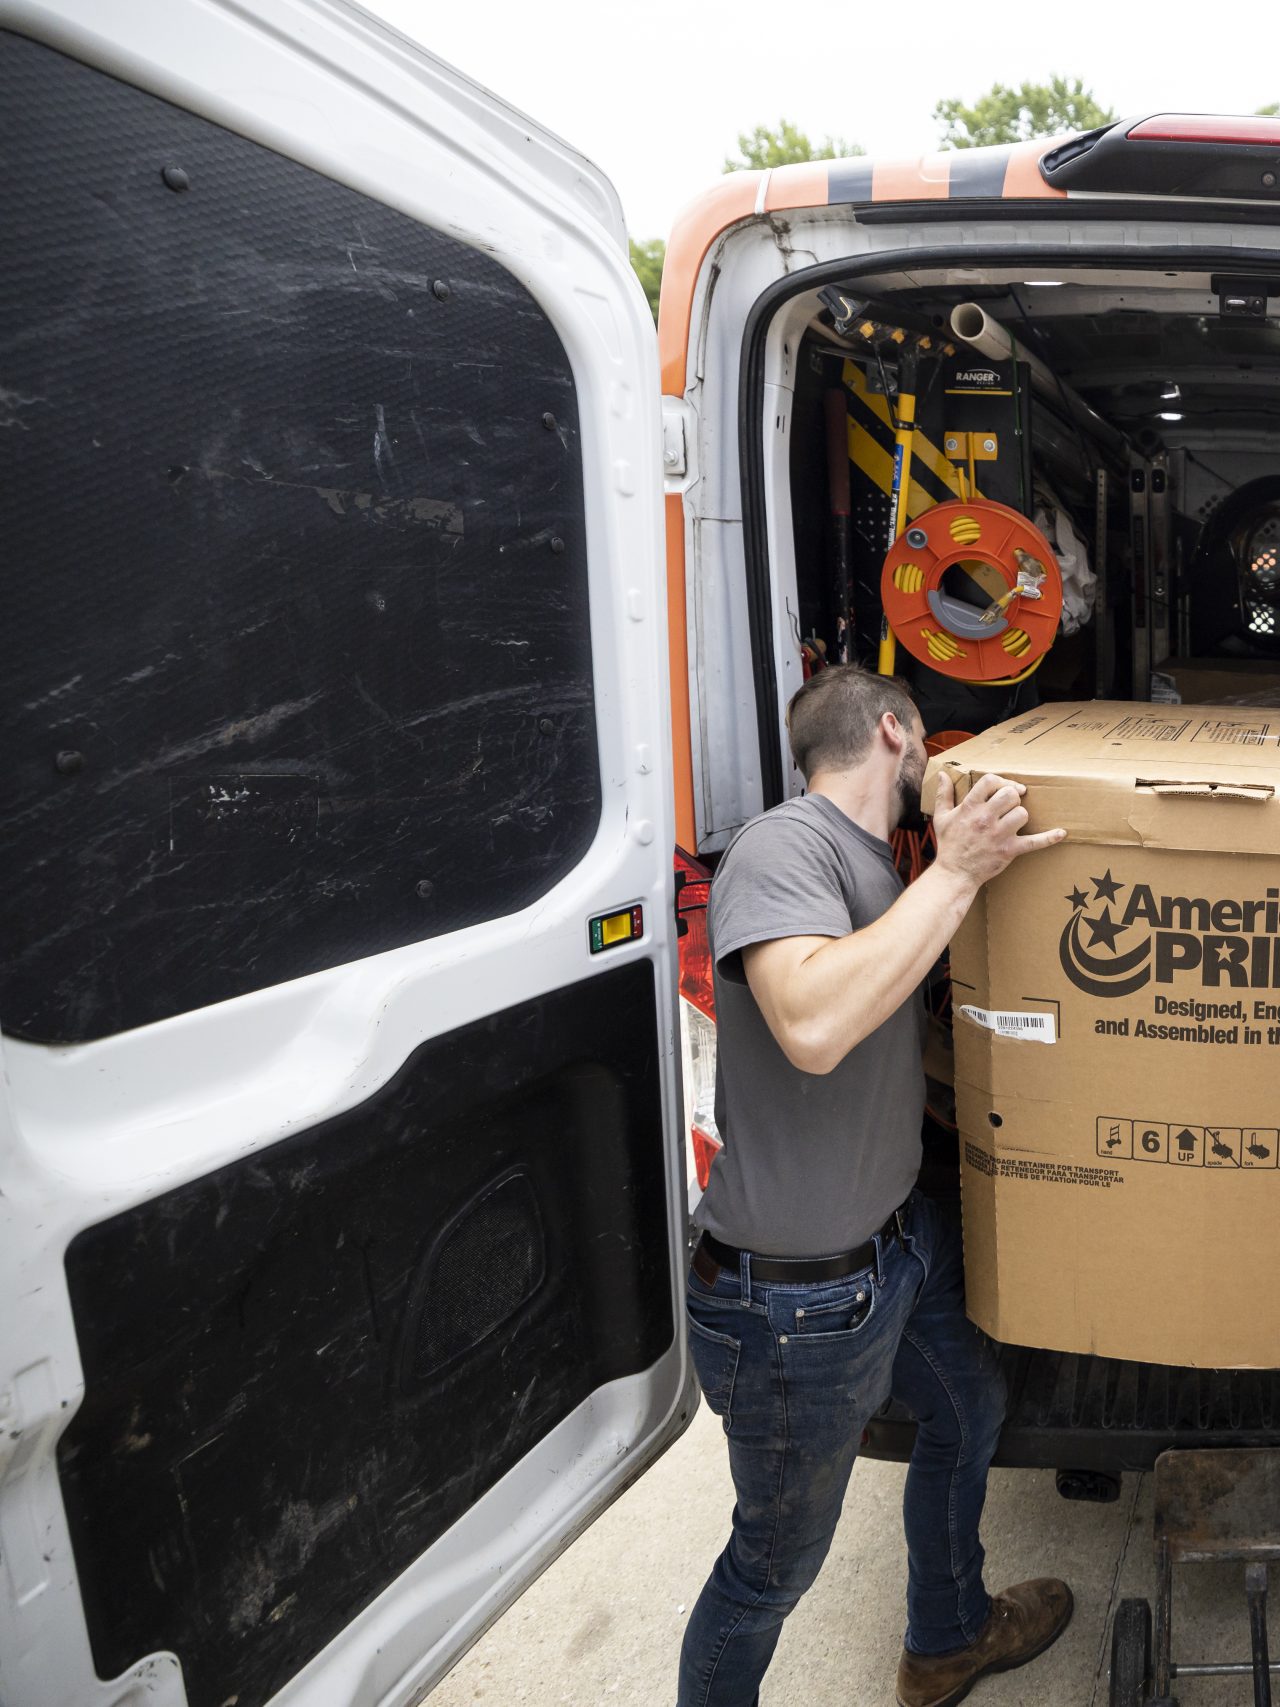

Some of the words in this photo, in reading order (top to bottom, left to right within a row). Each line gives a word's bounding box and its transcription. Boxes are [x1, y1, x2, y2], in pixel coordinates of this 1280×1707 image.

[956, 372, 994, 381] RANGER
[1154, 996, 1247, 1022] Designed,
[1095, 1018, 1128, 1036] and
[1134, 1019, 1238, 1044] Assembled
[1244, 1026, 1261, 1044] in
[1142, 1130, 1160, 1153] 6
[1178, 1152, 1195, 1162] UP
[1001, 1165, 1045, 1174] RETENEDOR
[1047, 1169, 1067, 1177] PARA
[1069, 1172, 1124, 1183] TRANSPORTAR
[1018, 1160, 1055, 1169] RETAINER
[1074, 1166, 1119, 1176] TRANSPORT
[1000, 1170, 1028, 1179] PATTES
[1042, 1175, 1077, 1184] FIXATION
[1079, 1178, 1100, 1186] POUR
